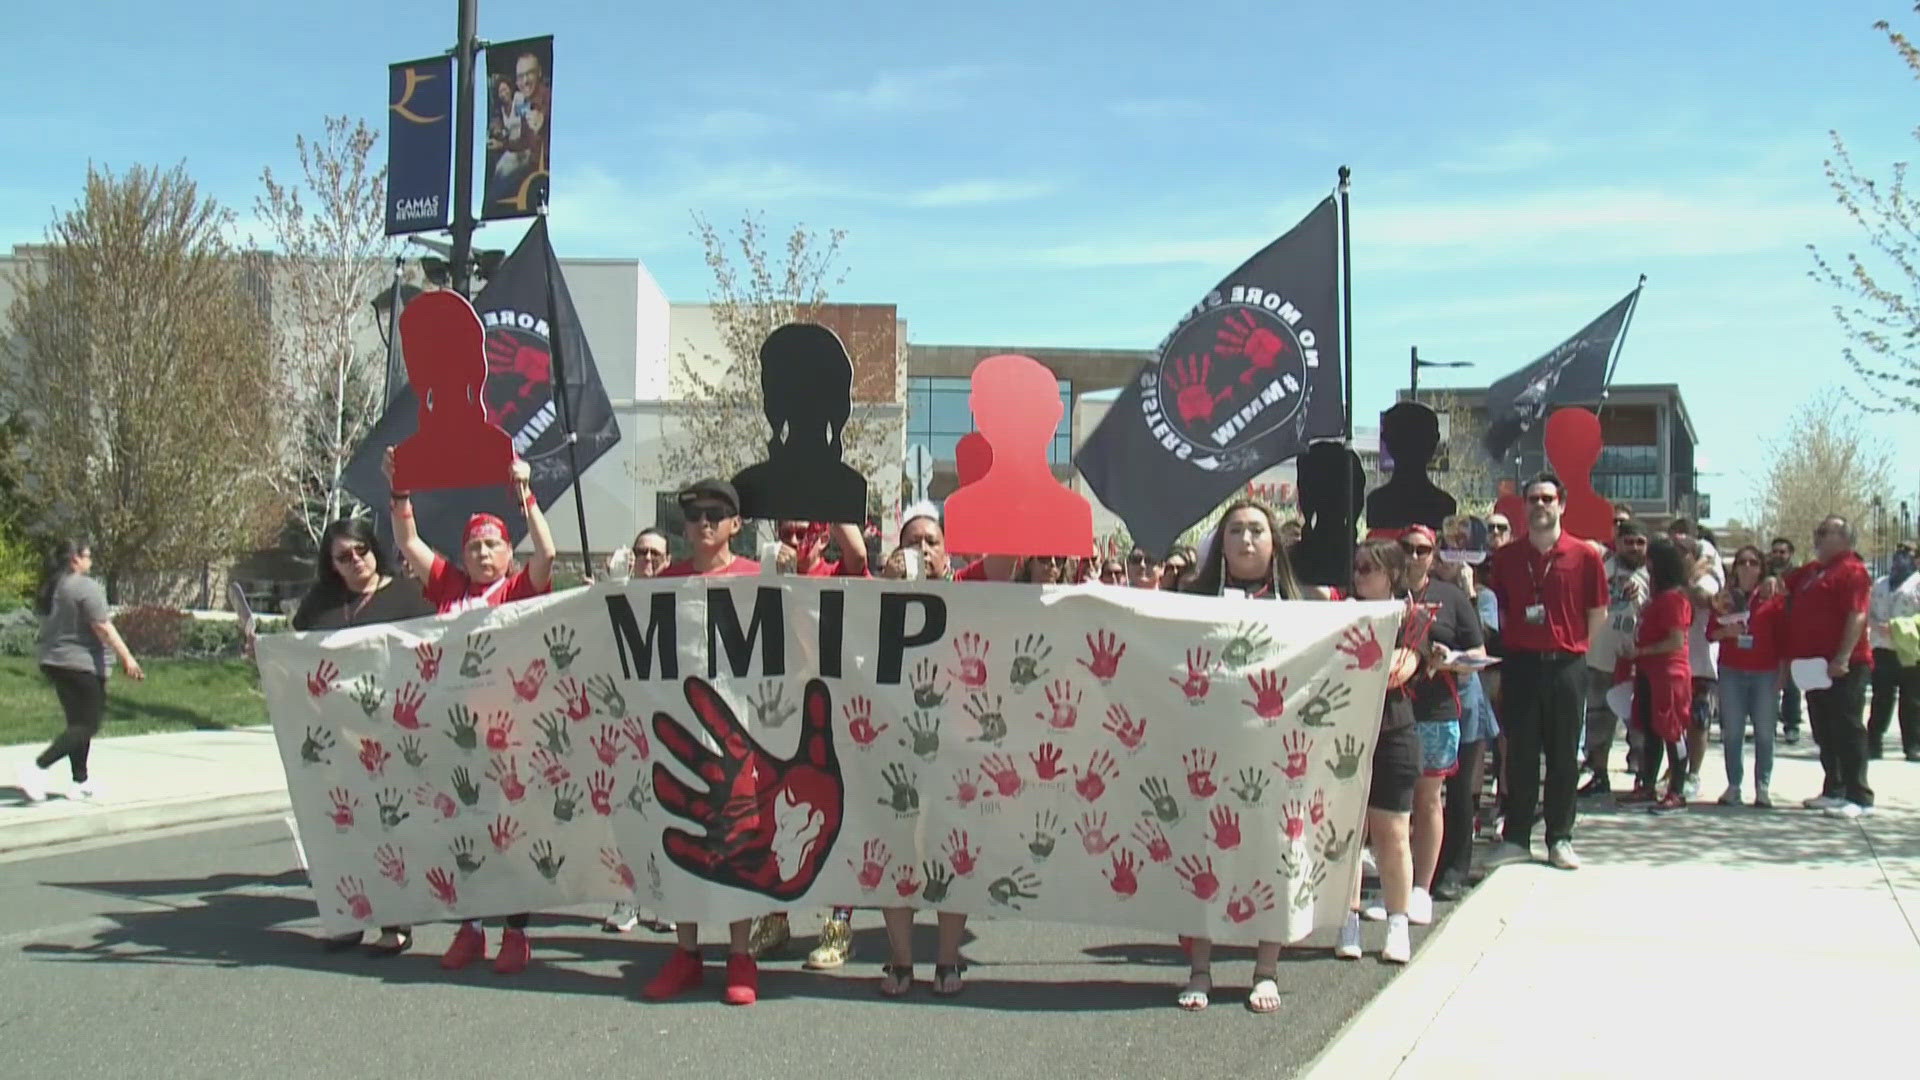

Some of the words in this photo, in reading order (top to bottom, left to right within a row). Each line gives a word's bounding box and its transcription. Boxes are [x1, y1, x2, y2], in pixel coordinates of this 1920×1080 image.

[396, 195, 439, 211] CAMAS
[396, 206, 438, 220] REWARDS
[604, 586, 947, 685] MMIP
